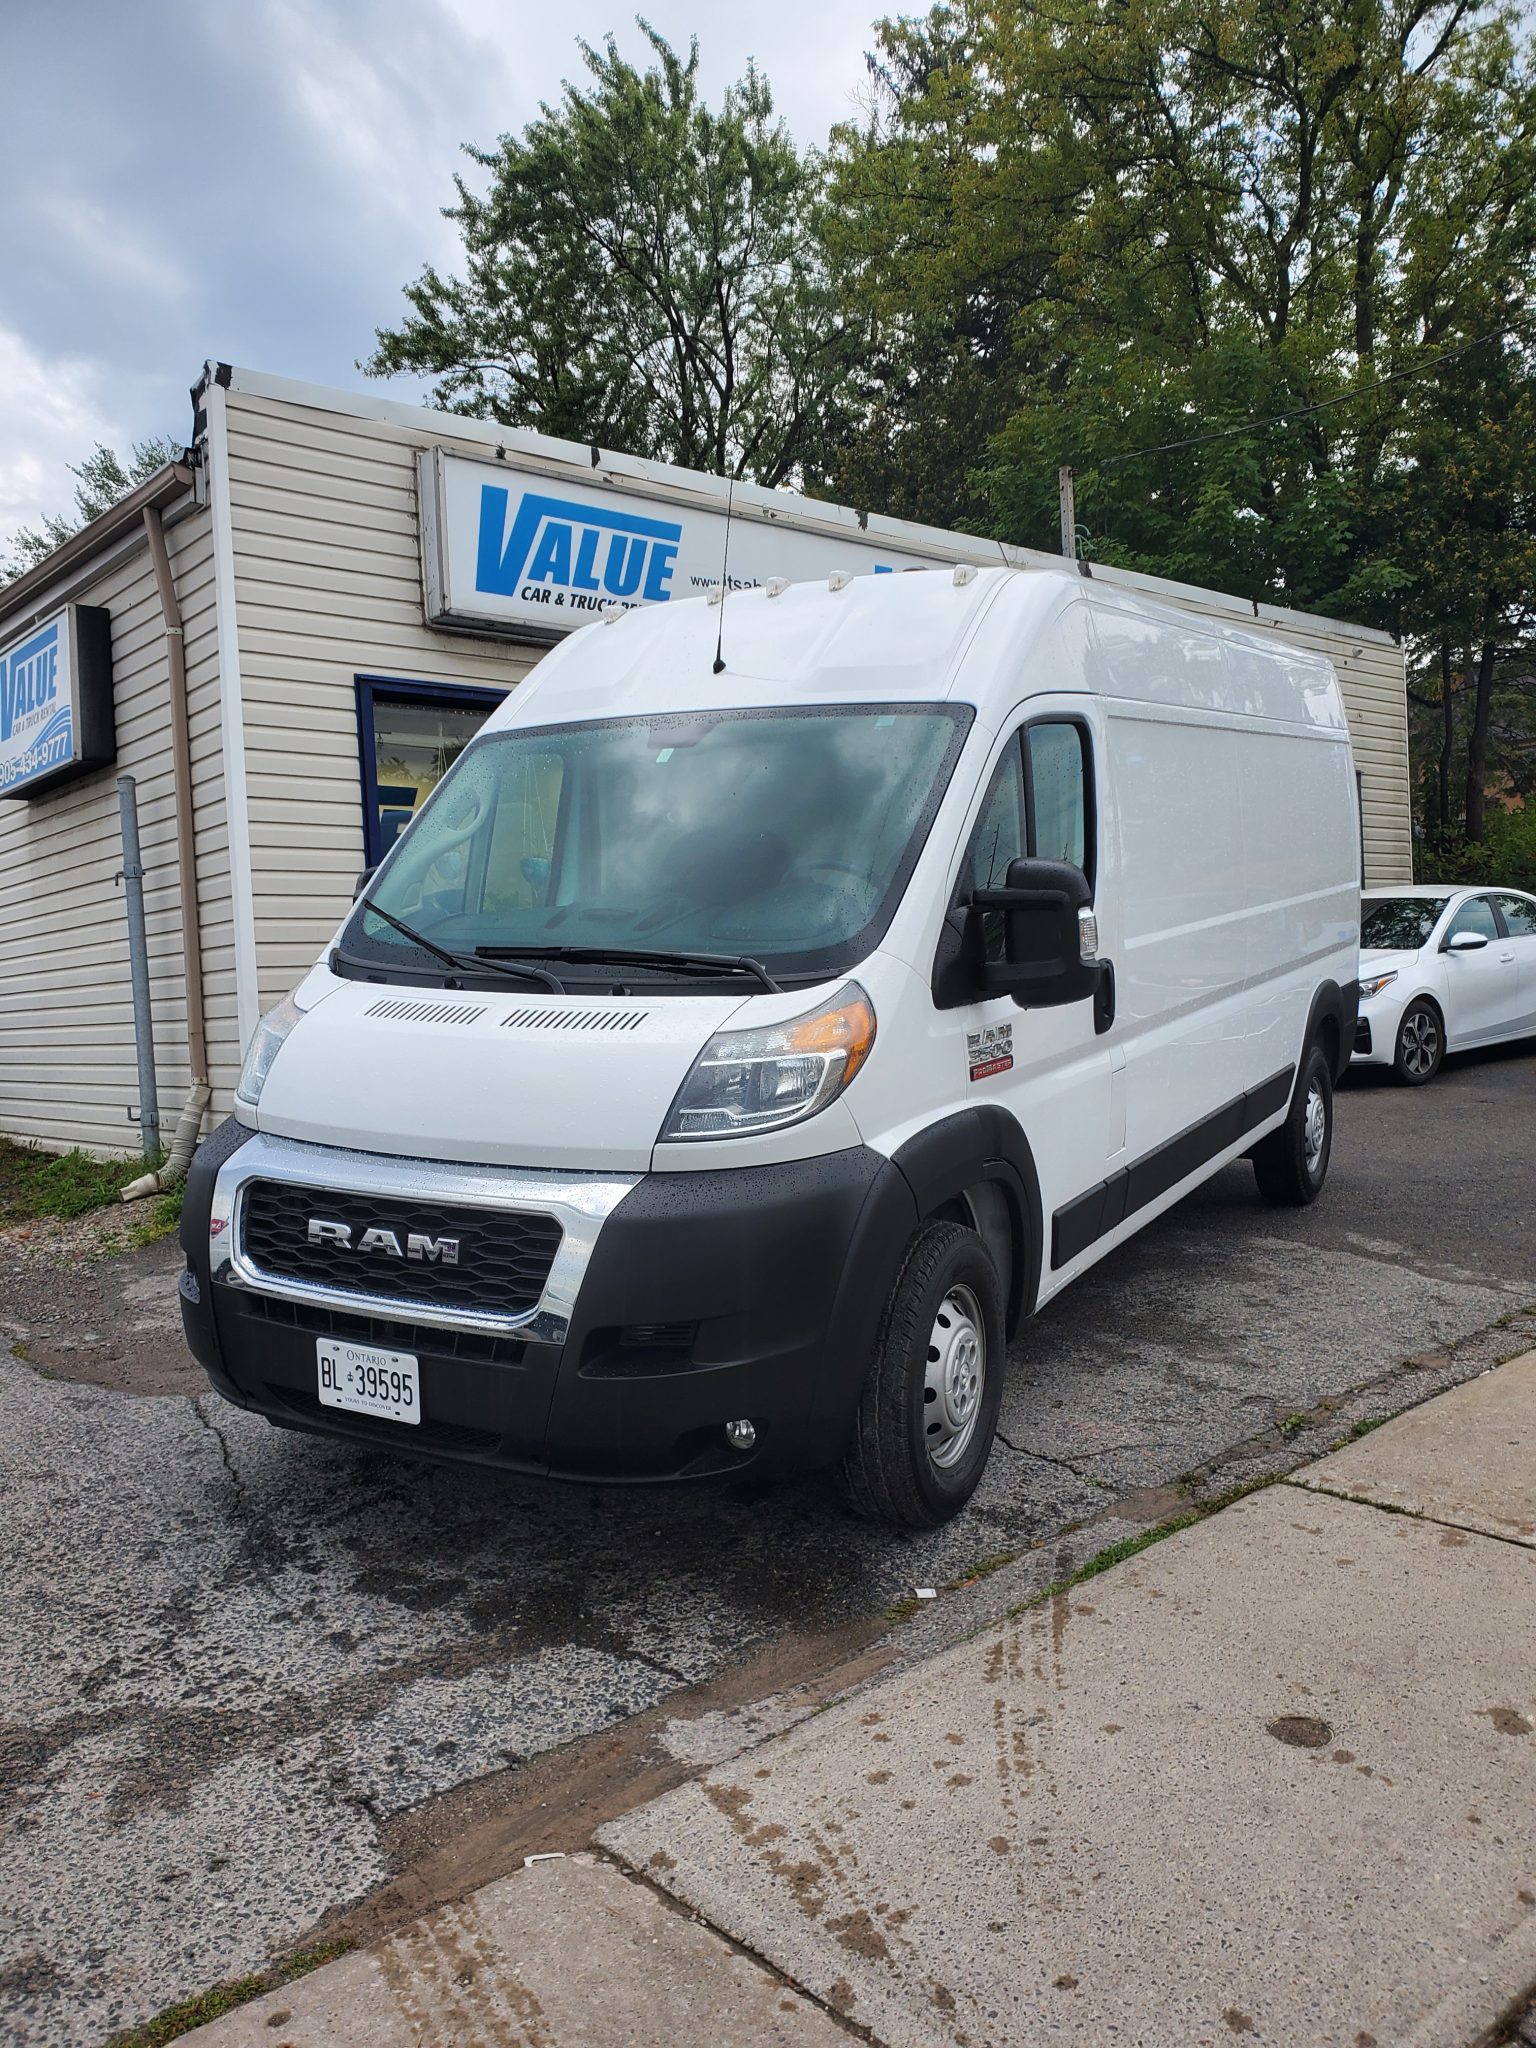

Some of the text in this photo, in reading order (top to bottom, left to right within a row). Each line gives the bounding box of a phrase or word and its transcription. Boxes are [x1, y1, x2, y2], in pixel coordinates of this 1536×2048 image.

[475, 484, 682, 601] VALUE
[521, 586, 552, 604] CAR
[555, 592, 565, 606] &
[0, 624, 58, 742] VALUE
[0, 731, 68, 786] 905-434-9777
[966, 1023, 1013, 1049] RAM
[308, 1218, 460, 1264] RAM
[321, 1356, 413, 1406] BL 39595
[347, 1349, 387, 1366] ONTARIO
